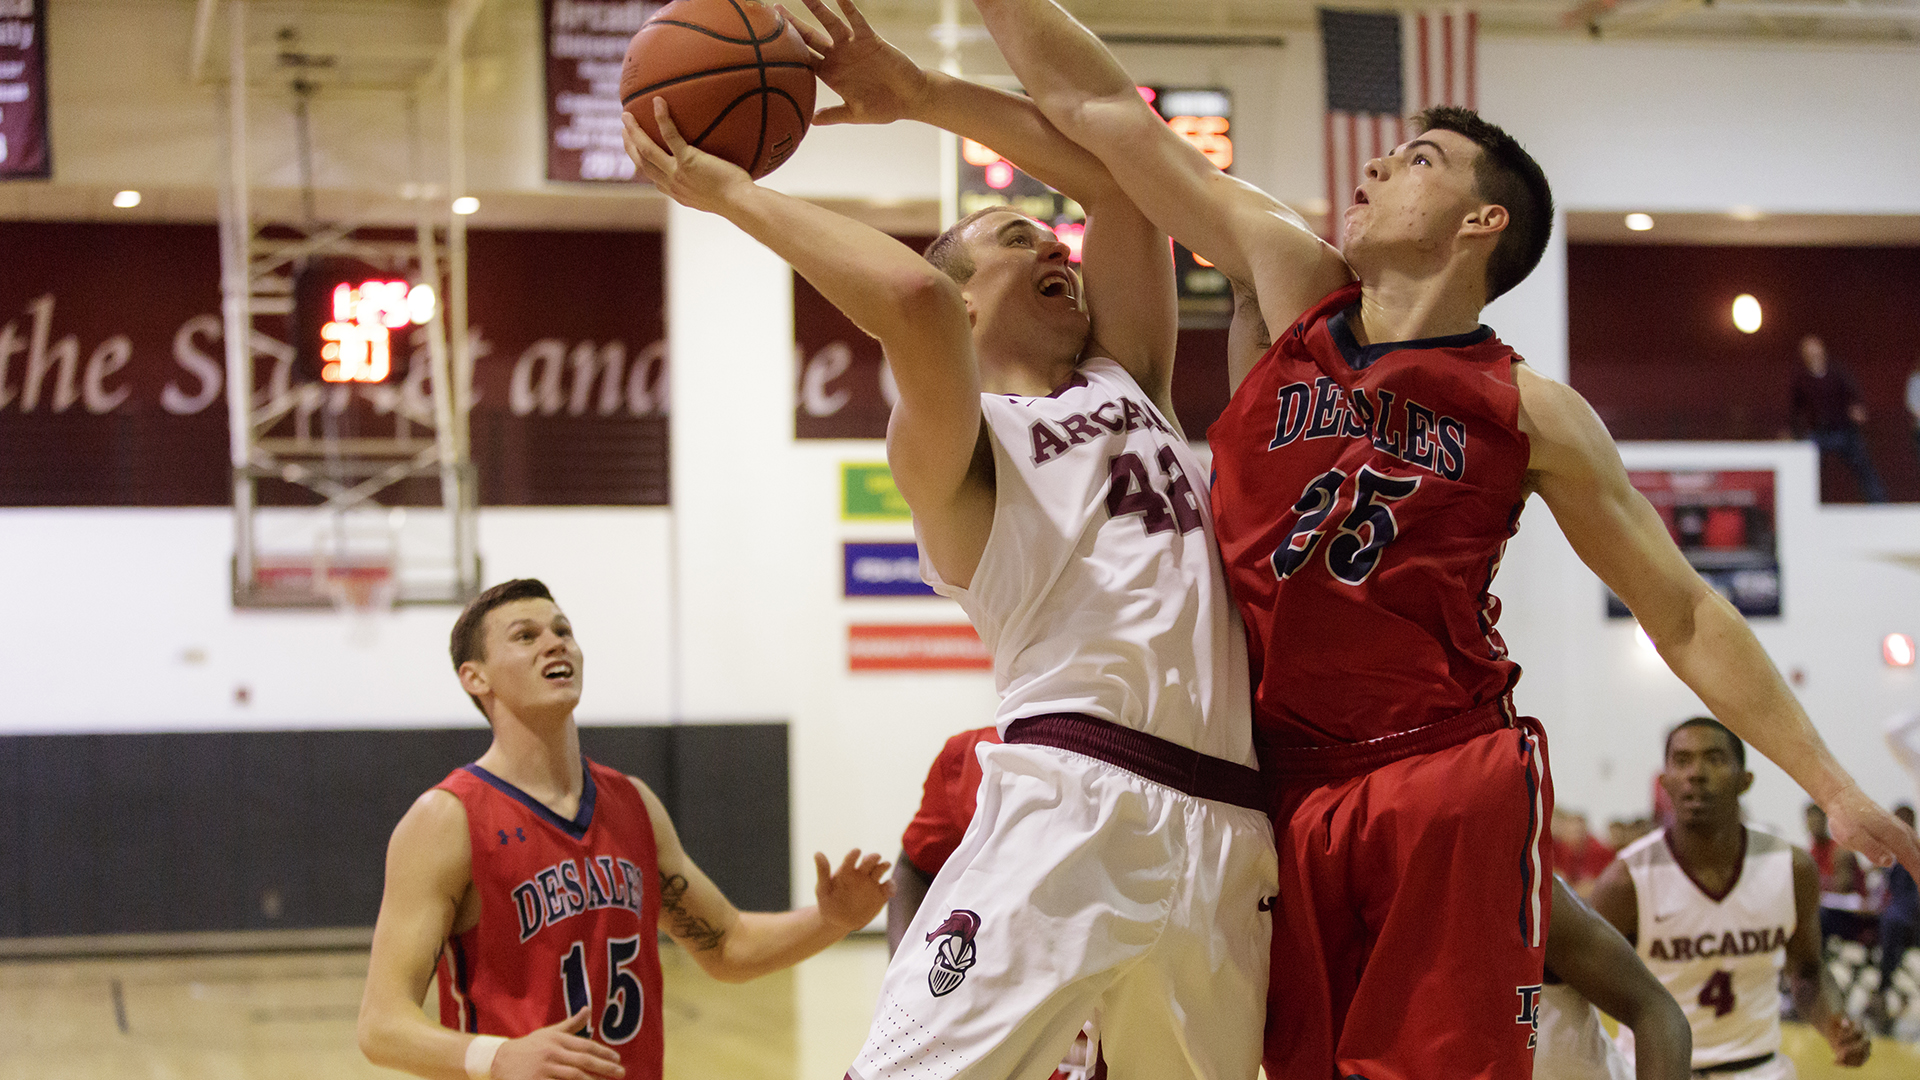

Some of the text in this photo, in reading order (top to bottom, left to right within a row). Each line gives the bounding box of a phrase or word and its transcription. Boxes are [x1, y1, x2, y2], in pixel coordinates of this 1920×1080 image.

[0, 292, 133, 415] the
[1103, 442, 1204, 538] 42
[1269, 463, 1423, 587] 25
[511, 854, 643, 944] DESALE
[1650, 926, 1787, 961] ARCADIA
[560, 933, 644, 1046] 15
[1697, 968, 1736, 1018] 4
